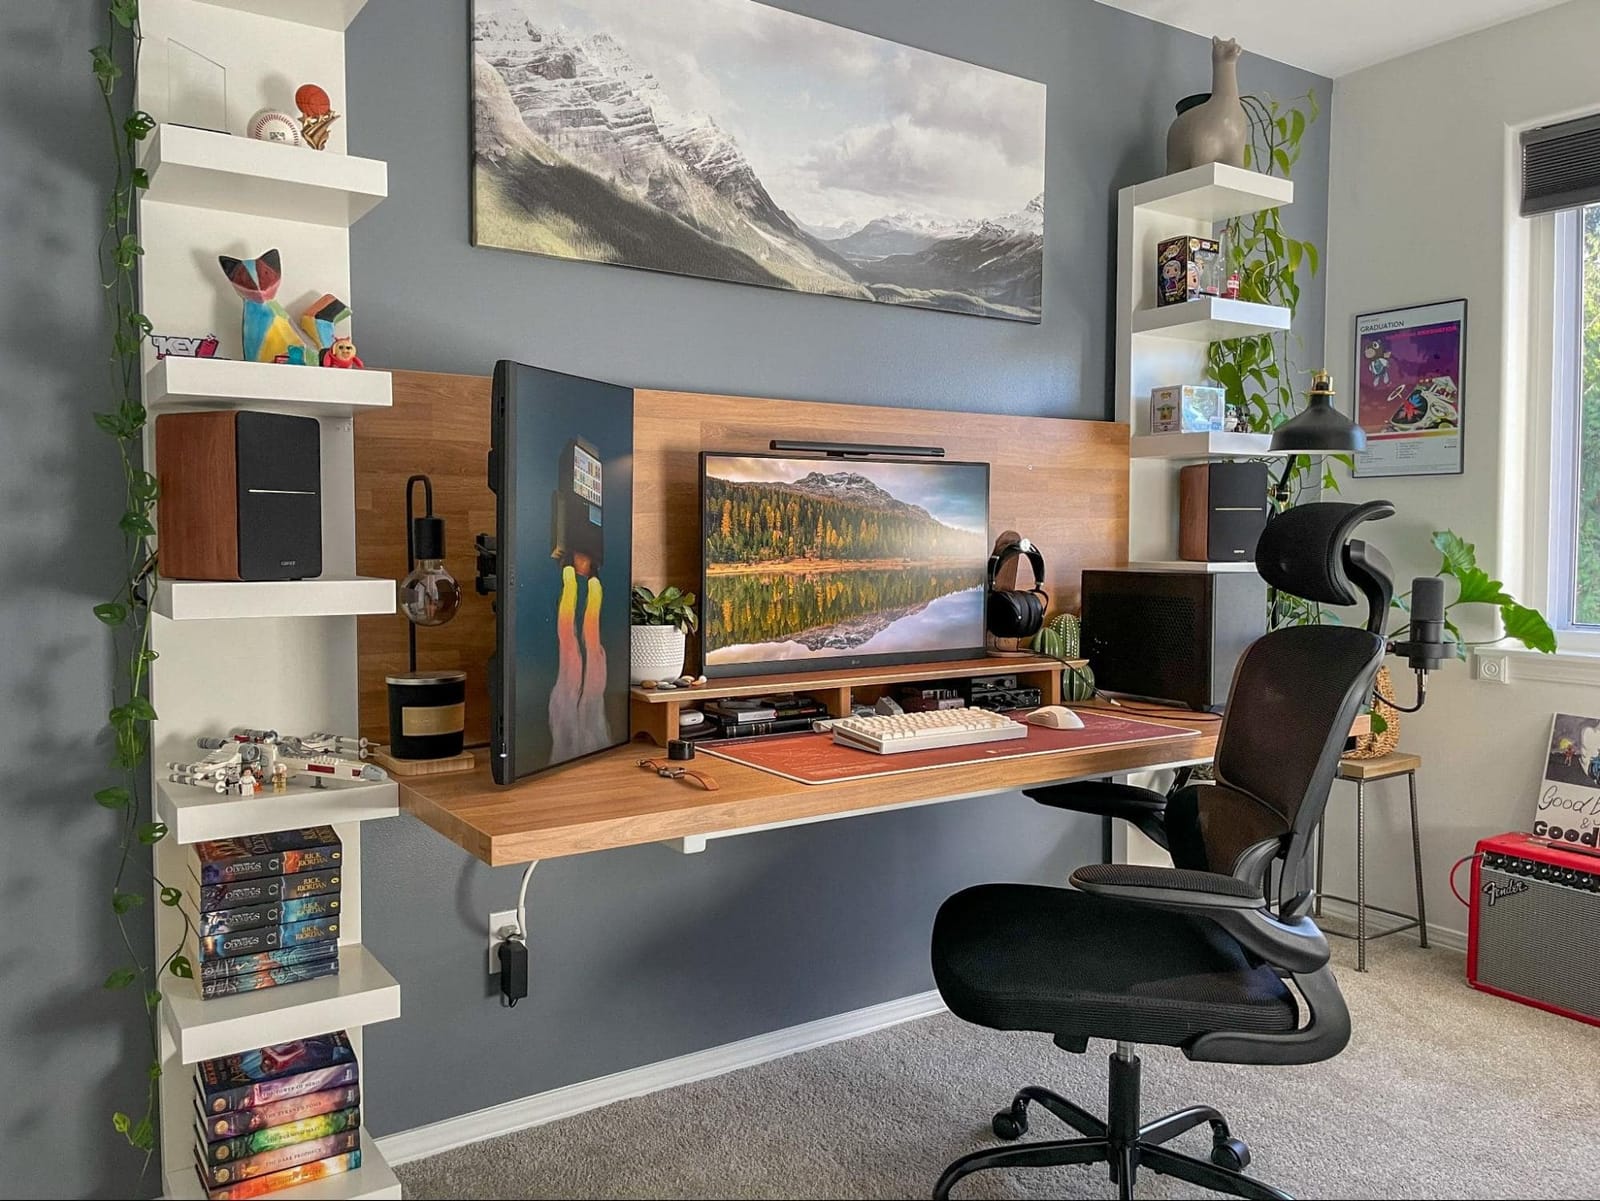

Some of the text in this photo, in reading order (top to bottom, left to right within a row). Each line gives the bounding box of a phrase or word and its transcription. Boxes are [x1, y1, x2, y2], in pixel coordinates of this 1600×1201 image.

[1360, 320, 1405, 333] GRADUATION
[1539, 785, 1593, 813] Good
[1483, 878, 1529, 907] Fender
